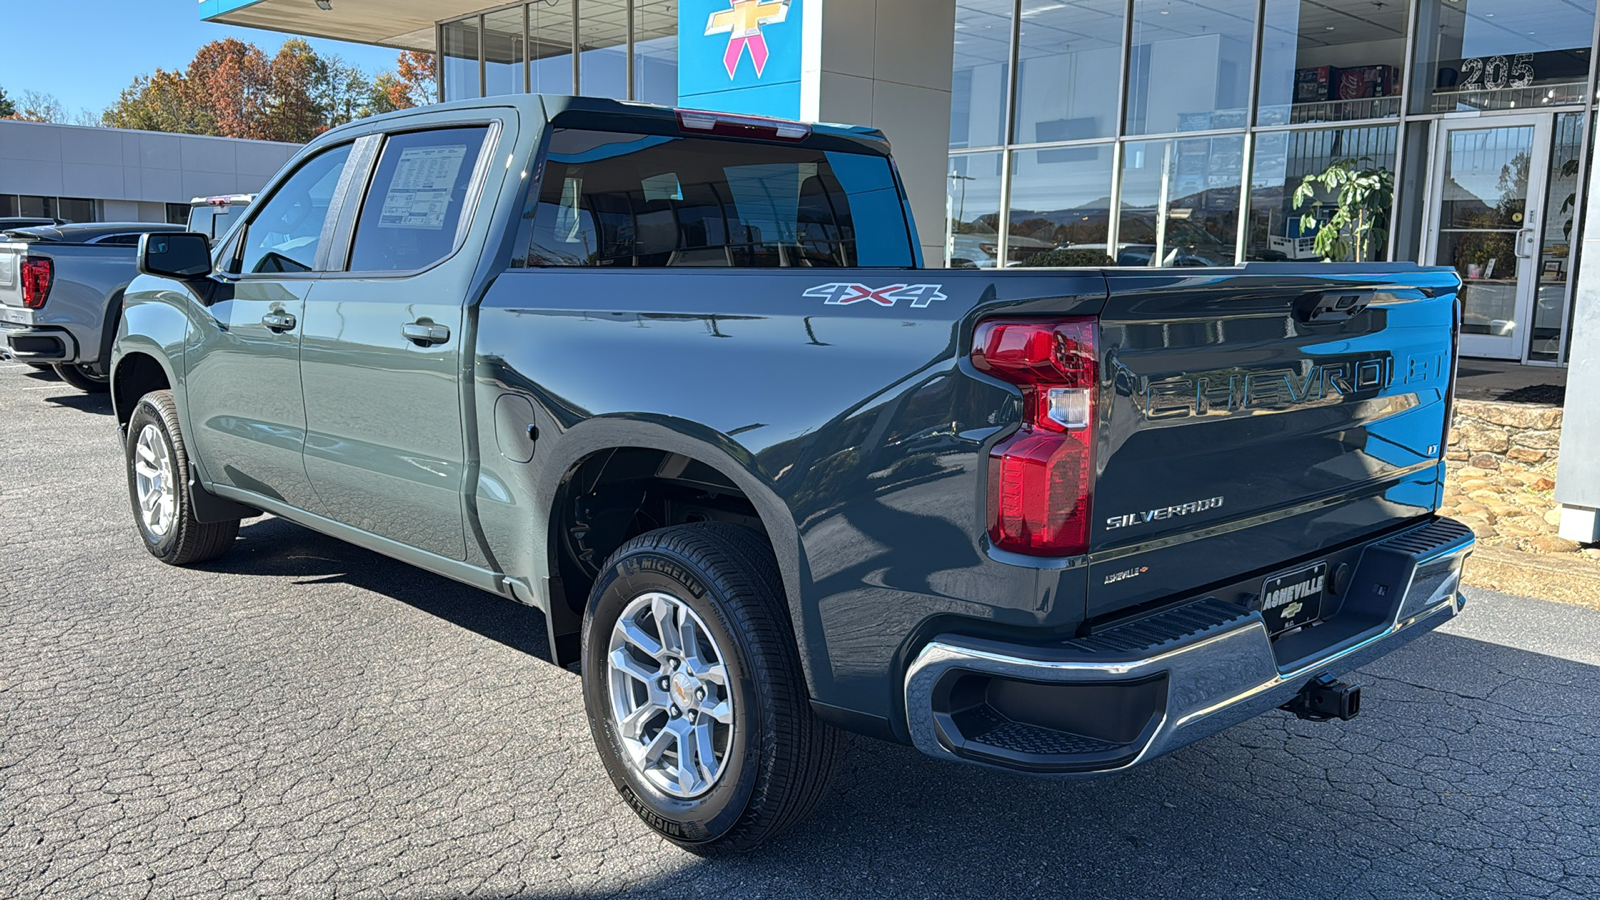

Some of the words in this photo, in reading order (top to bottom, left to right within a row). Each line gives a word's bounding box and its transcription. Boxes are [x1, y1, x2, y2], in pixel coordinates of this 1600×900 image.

[1459, 53, 1535, 92] 205
[1145, 349, 1449, 421] CHEVROLET
[1427, 444, 1439, 456] LT
[1106, 496, 1224, 531] SILVERADO
[641, 558, 703, 597] MICHELIN
[1104, 567, 1140, 585] ASHEVILLE
[1262, 575, 1325, 611] ASHEVILLE
[623, 787, 681, 836] MICHELIN
